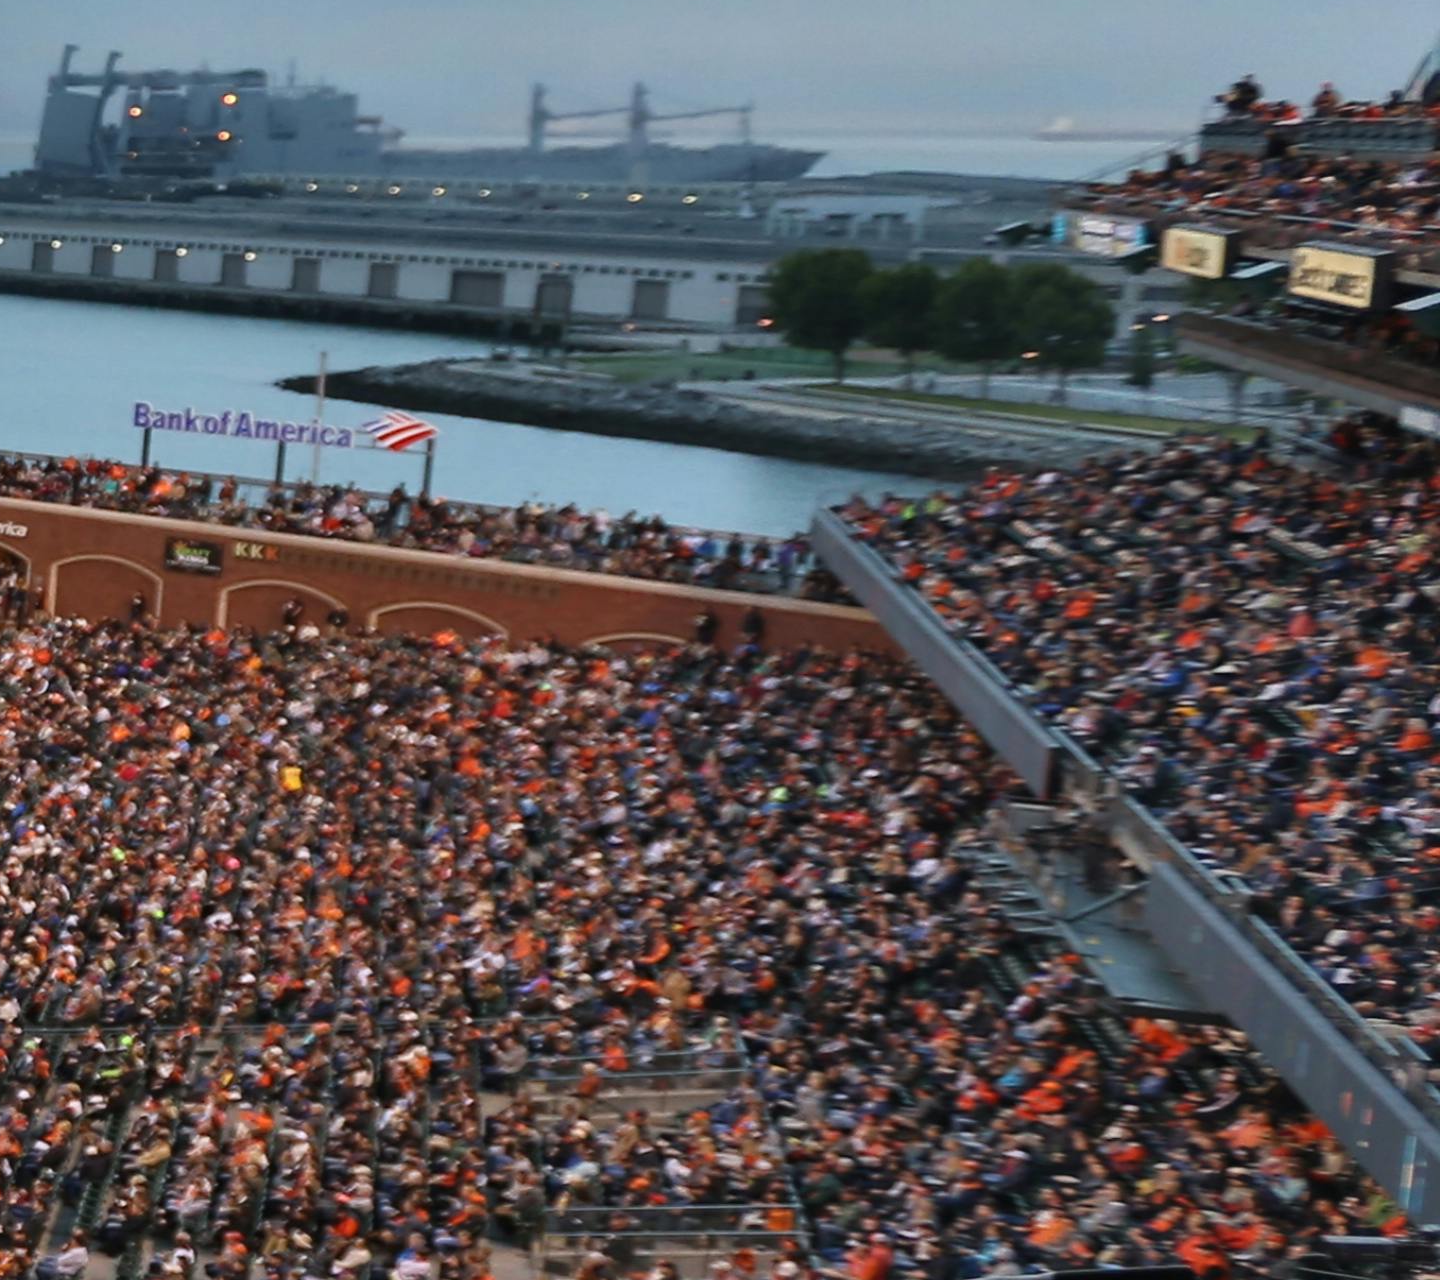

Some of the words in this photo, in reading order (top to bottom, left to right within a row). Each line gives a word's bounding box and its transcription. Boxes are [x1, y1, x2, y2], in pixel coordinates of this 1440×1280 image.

[134, 402, 204, 433] Bank
[204, 410, 232, 435] of
[235, 412, 353, 448] America
[235, 542, 249, 556] K
[250, 545, 263, 558] K
